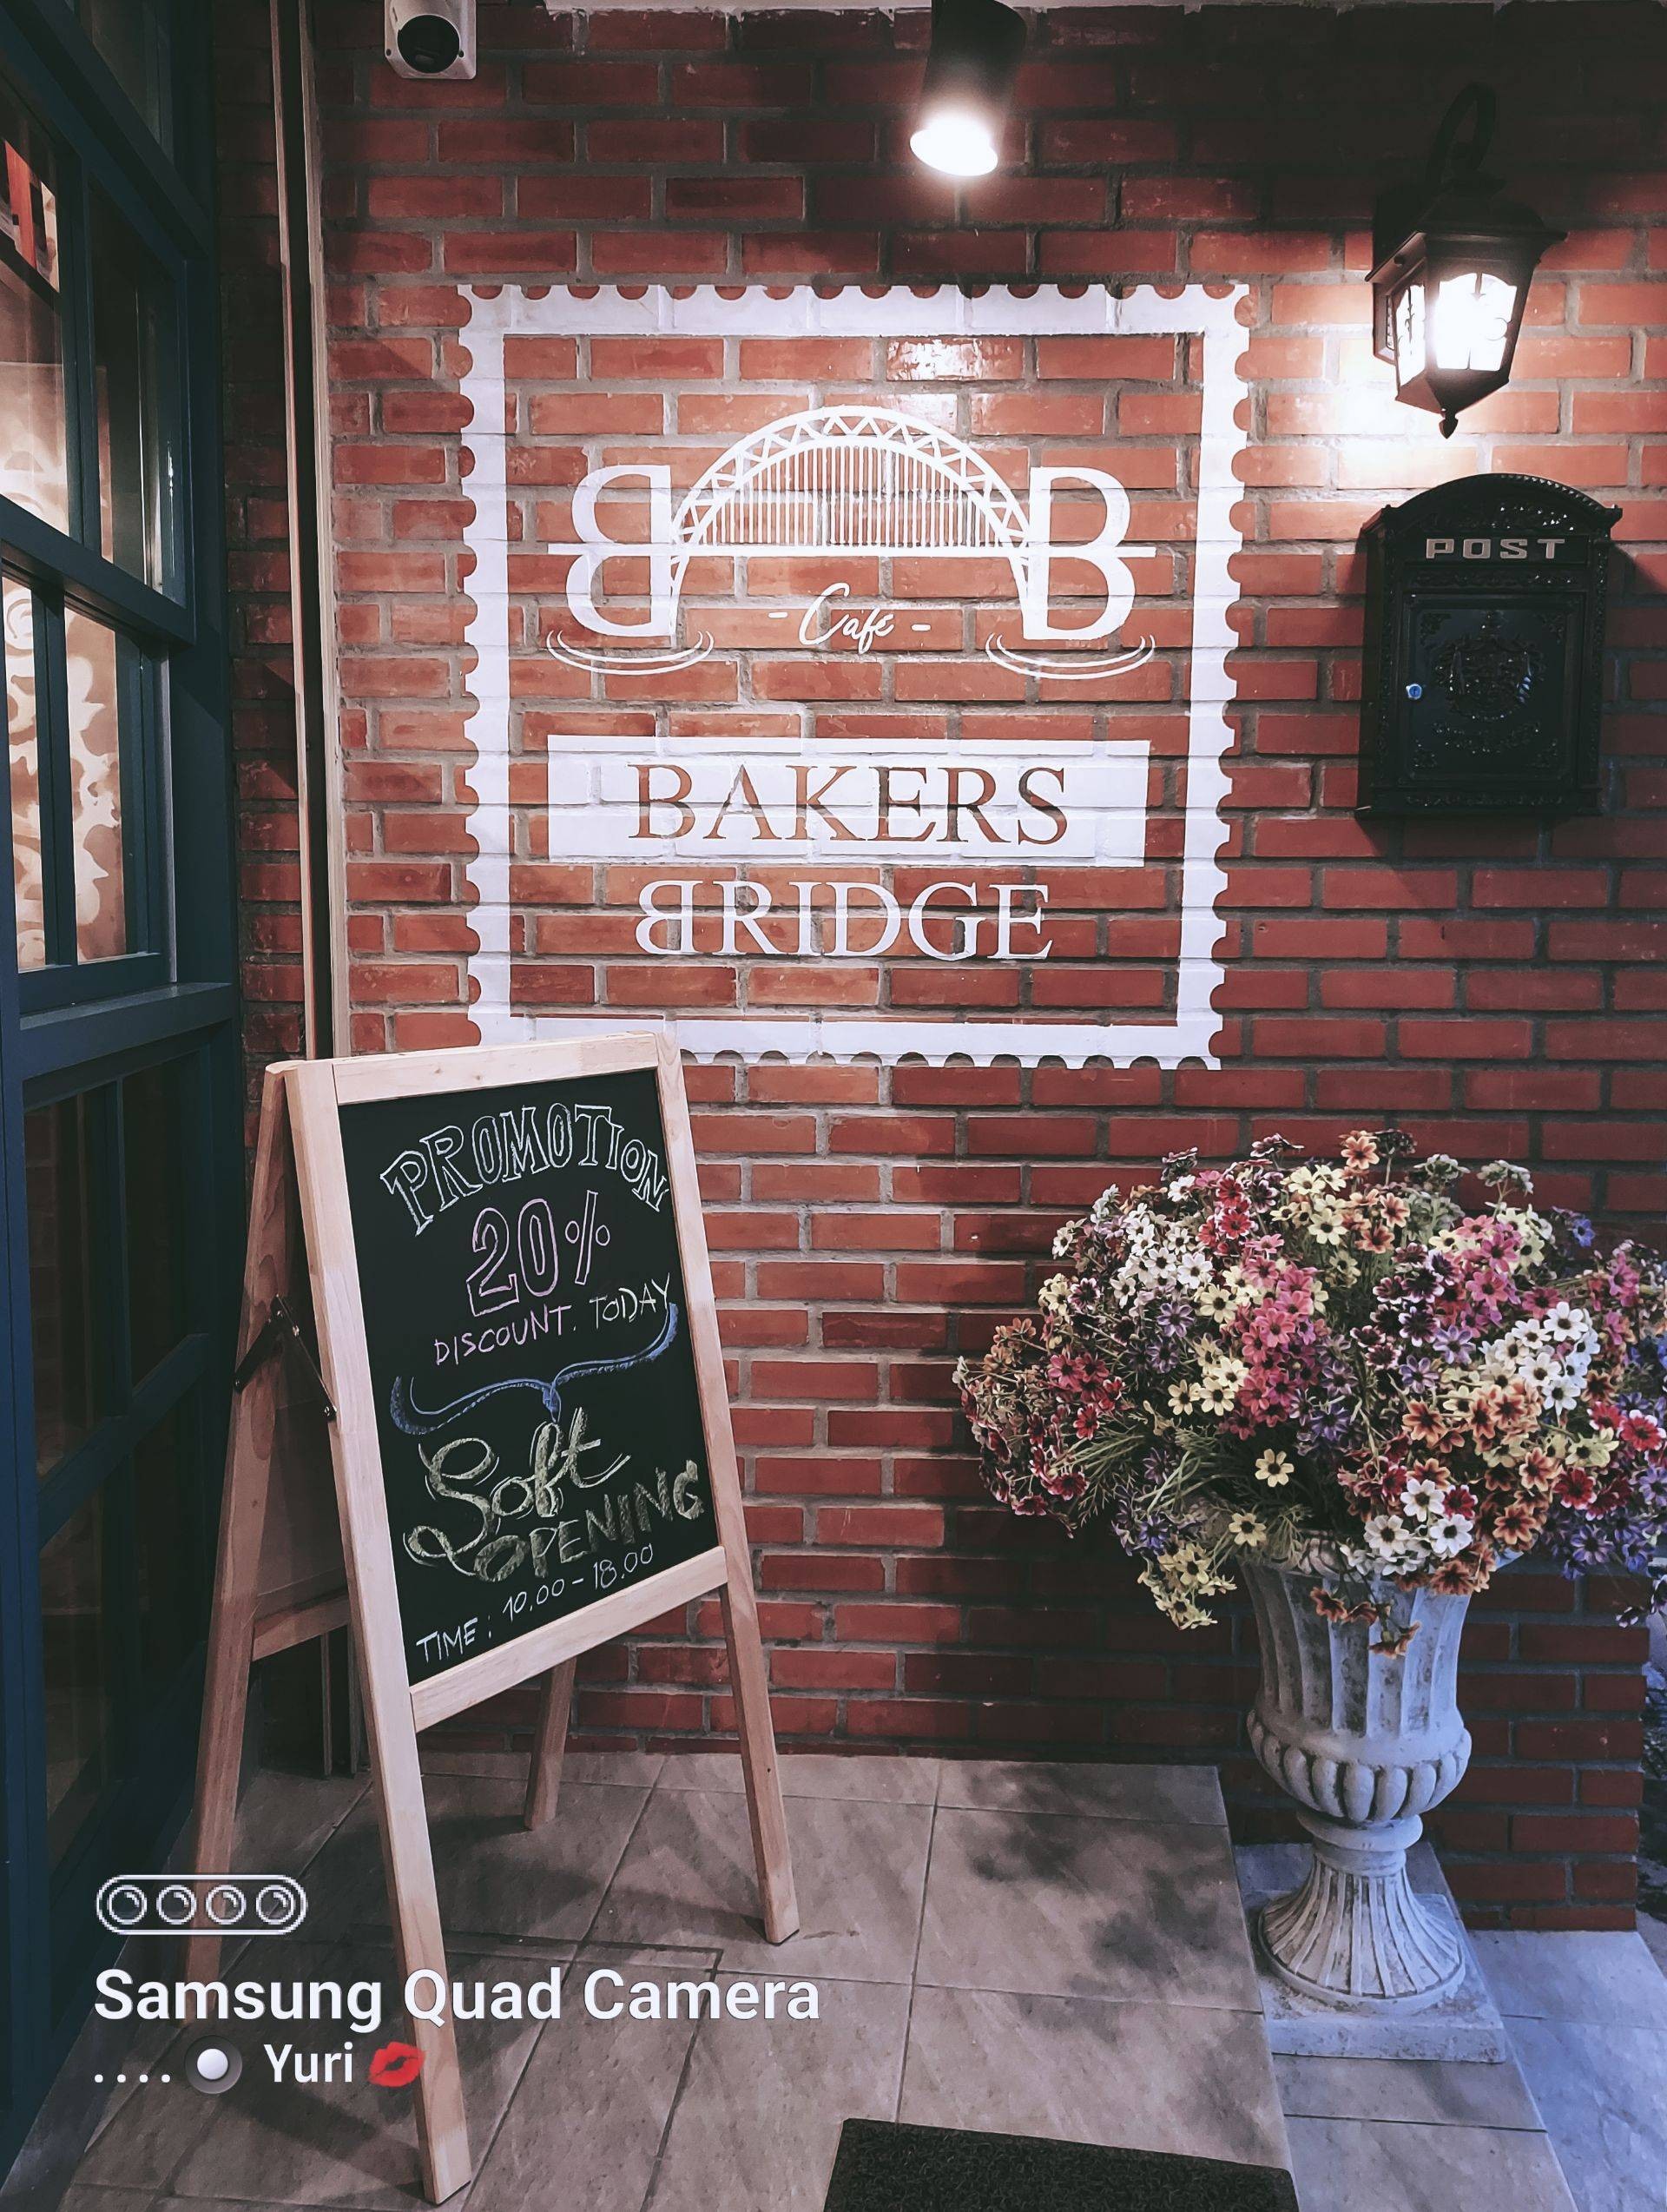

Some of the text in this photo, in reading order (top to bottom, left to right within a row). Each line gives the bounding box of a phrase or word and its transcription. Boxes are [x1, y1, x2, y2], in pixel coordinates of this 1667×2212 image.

[1023, 467, 1136, 641] B
[1427, 538, 1565, 559] POST
[627, 764, 1068, 845] BAKERS
[635, 880, 1053, 961] BRIDGE
[379, 1103, 669, 1237] PROMOTION
[465, 1191, 611, 1317] 20%
[590, 1272, 670, 1329] TODAY
[403, 1406, 631, 1576] Soft
[474, 1459, 705, 1581] OPENING
